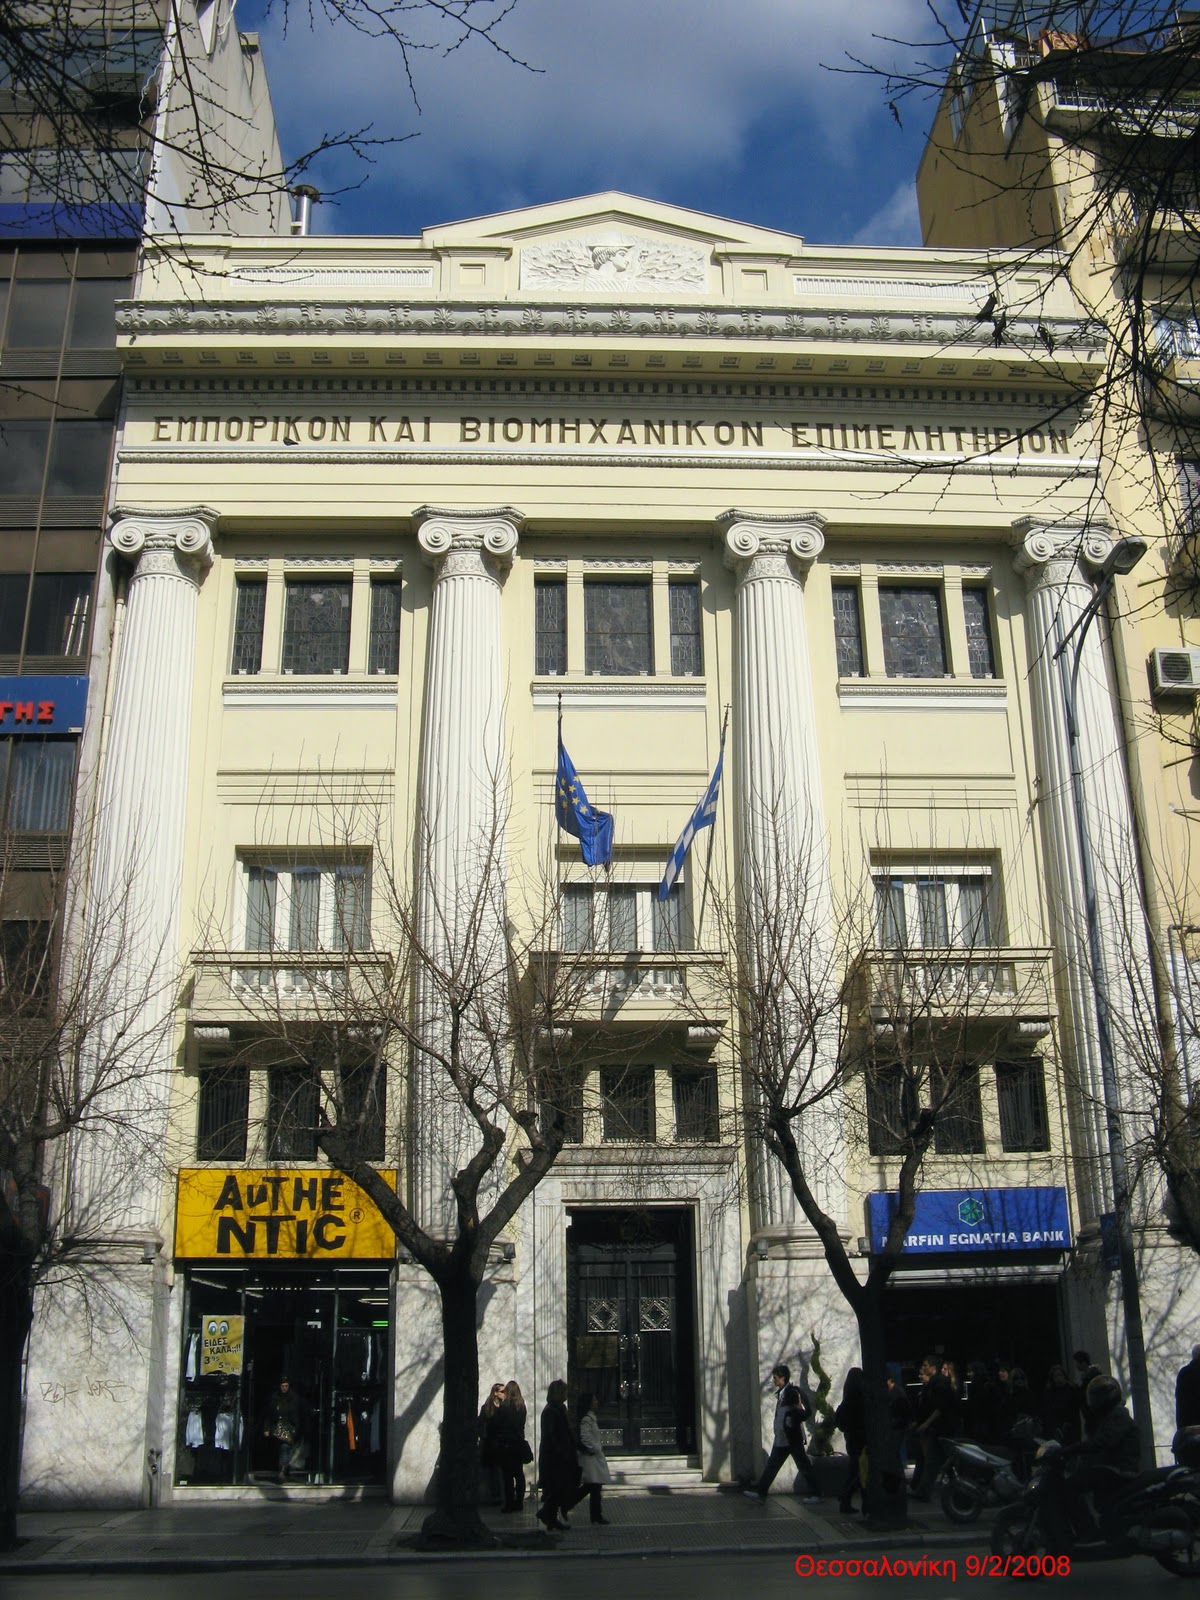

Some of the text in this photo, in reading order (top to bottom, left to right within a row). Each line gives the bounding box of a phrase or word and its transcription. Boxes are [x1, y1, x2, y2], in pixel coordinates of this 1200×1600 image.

[152, 416, 1070, 455] ΕΜΠΟΡΙΚΟΝ ΚΑΙ ΒΙΟΜΗΧΑΝΙΚΟΝ ΕΠΙΜΕΛΗΤΗΡΙΟΝ
[949, 1231, 1018, 1245] EGNATIA
[1023, 1230, 1064, 1243] BANK
